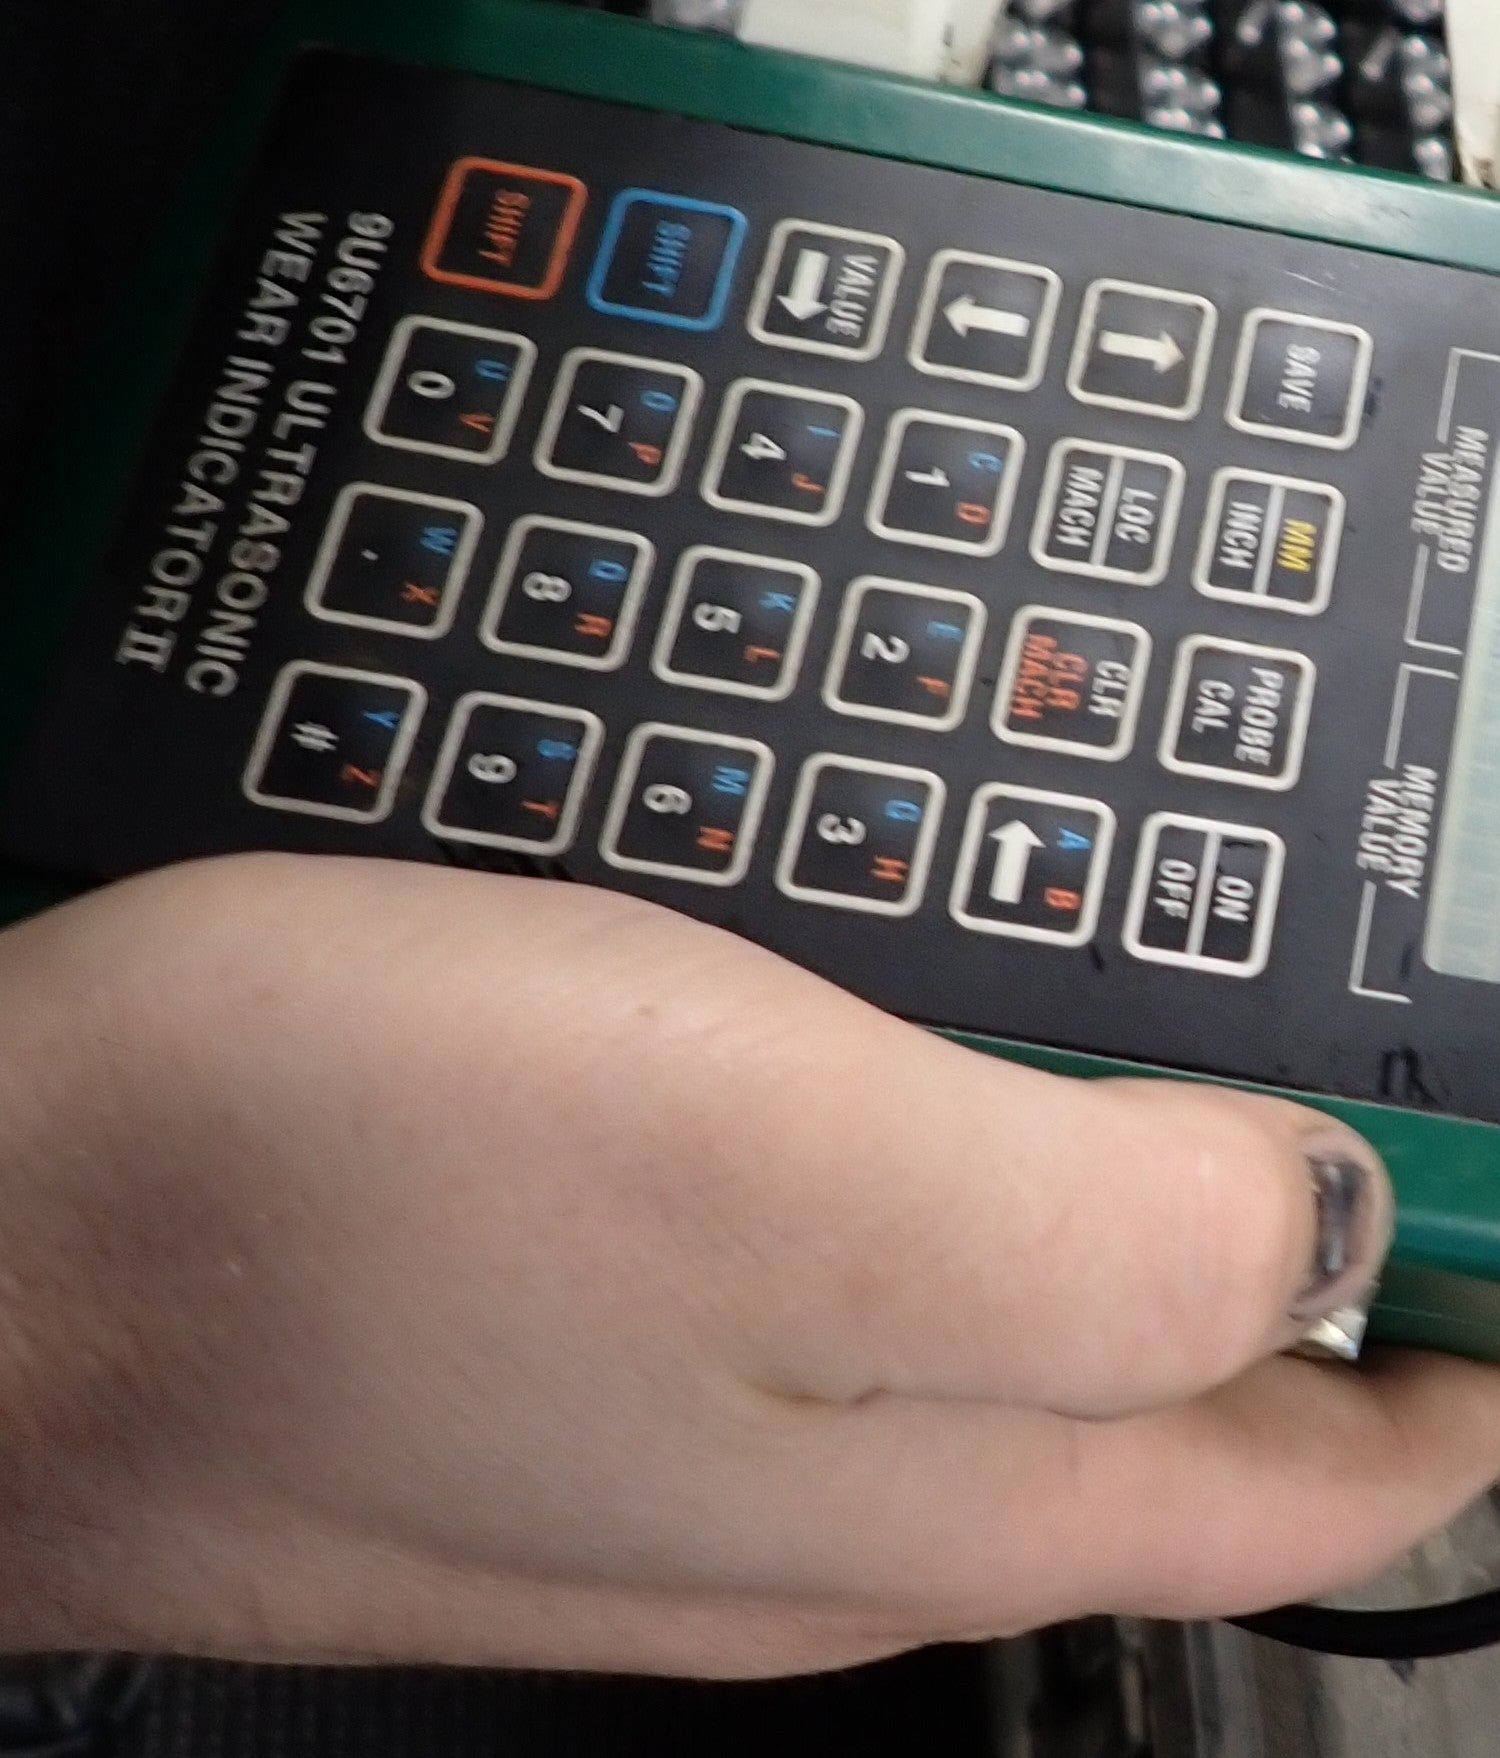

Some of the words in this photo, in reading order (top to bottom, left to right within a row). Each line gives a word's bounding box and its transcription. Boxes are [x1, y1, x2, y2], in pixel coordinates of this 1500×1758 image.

[479, 190, 530, 266] SHIFT
[642, 219, 692, 298] SHIFT
[234, 211, 329, 347] WEAR
[300, 210, 397, 365] 9U6701
[824, 253, 880, 339] VALUE
[406, 370, 456, 399] 0
[1276, 343, 1321, 413] SAVE
[575, 404, 624, 433] 7
[739, 432, 786, 461] 4
[133, 354, 276, 622] INDICATOR
[903, 467, 950, 487] 1
[1054, 464, 1104, 547] MACH
[1410, 452, 1454, 536] VALUE
[1436, 425, 1489, 573] MEASURED
[184, 379, 338, 698] ULTRASONIC
[1114, 486, 1158, 545] LOC
[1218, 501, 1264, 570] INCH
[1276, 518, 1318, 573] MM
[521, 572, 572, 602] 8
[692, 603, 742, 634] 5
[859, 632, 910, 664] 2
[1010, 633, 1058, 720] MACH
[1191, 678, 1236, 735] CAL
[1233, 666, 1285, 767] PROBE
[465, 753, 517, 784] 9
[641, 783, 692, 815] 6
[815, 813, 866, 845] 3
[1356, 779, 1402, 873] VALUE
[1385, 763, 1438, 899] MEMORY
[1153, 857, 1197, 920] OFF
[1212, 875, 1255, 923] ON
